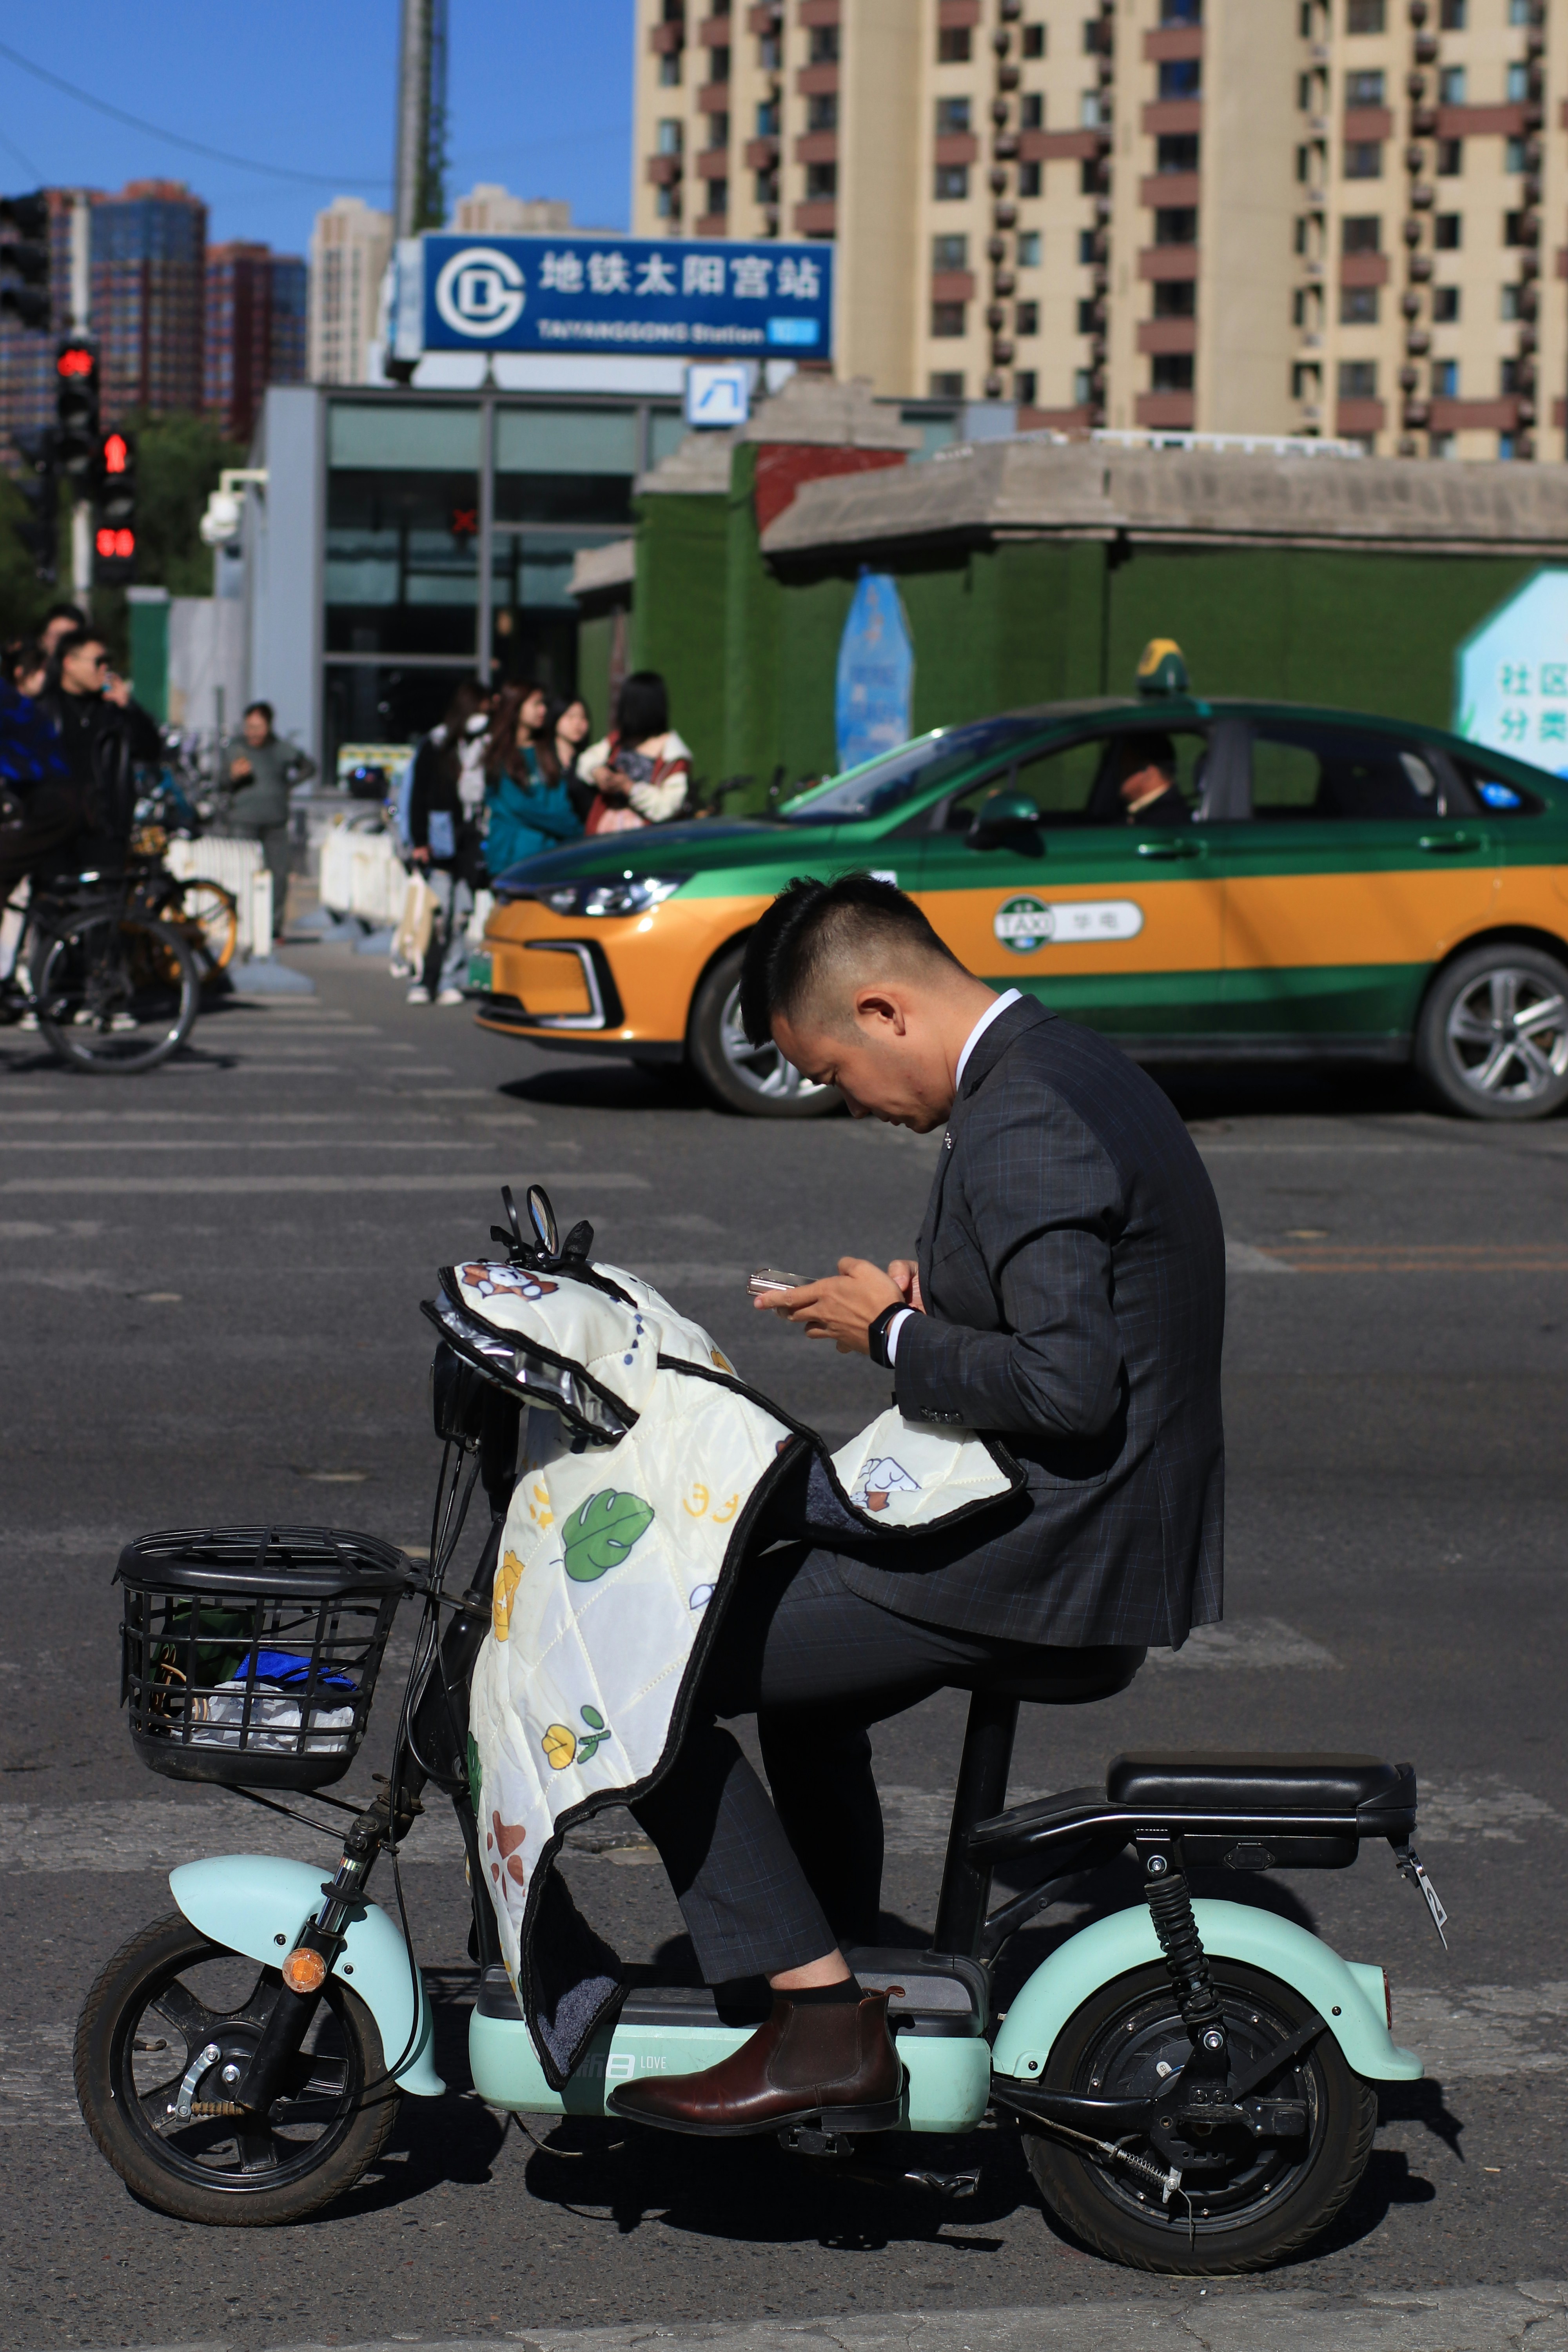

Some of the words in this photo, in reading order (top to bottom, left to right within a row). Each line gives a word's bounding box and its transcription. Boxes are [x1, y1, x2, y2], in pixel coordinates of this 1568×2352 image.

[539, 251, 821, 299] 地铁太阳宫站
[691, 322, 764, 345] Station
[1501, 663, 1568, 697] 社区
[1501, 708, 1567, 742] 分类
[1001, 916, 1050, 934] TAXI
[641, 2056, 666, 2069] LOVE
